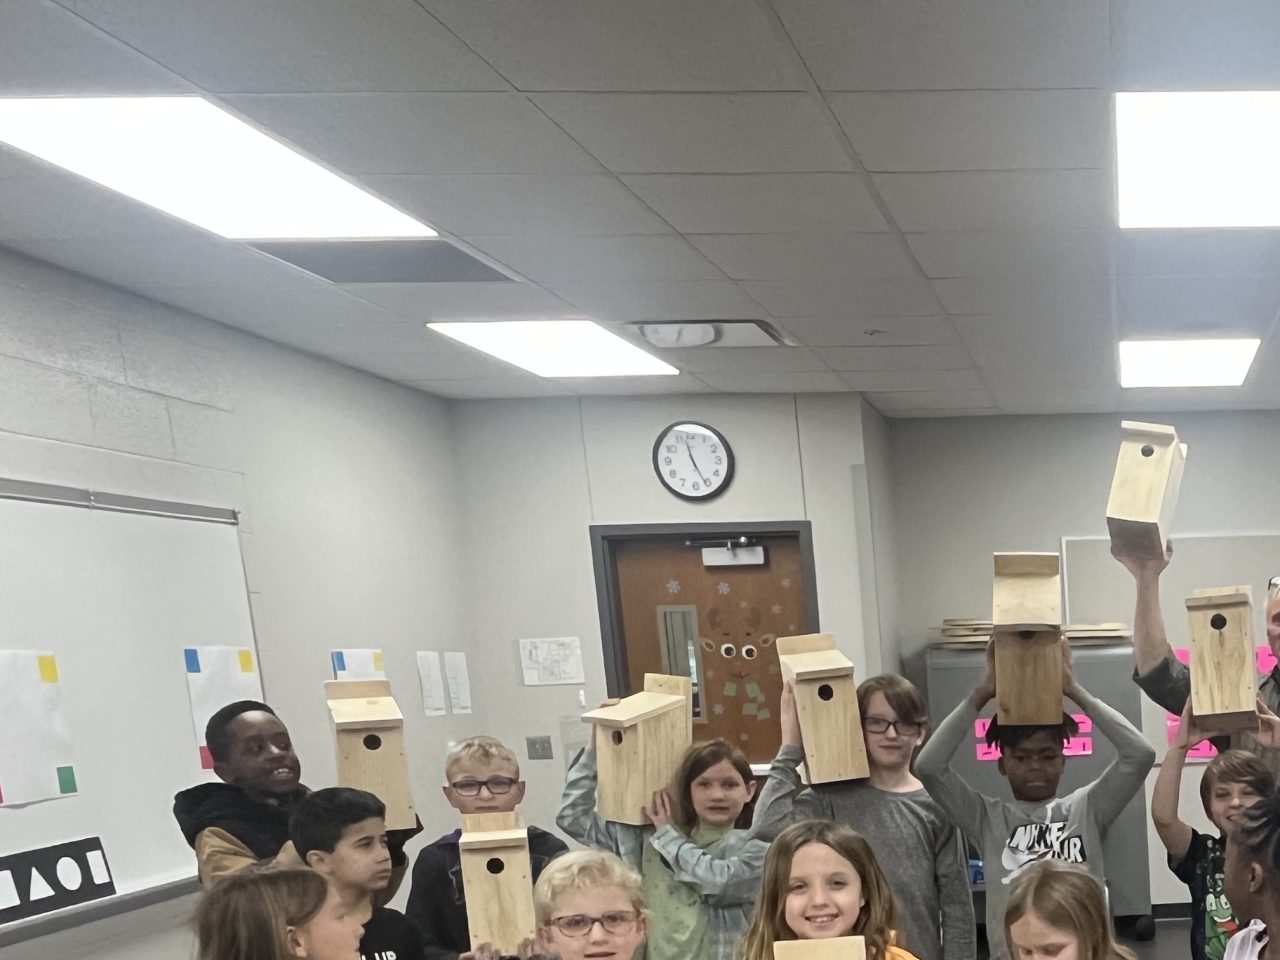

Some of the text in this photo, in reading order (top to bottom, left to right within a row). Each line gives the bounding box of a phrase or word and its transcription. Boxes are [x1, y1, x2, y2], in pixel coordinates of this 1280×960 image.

[675, 435, 683, 444] 11
[666, 444, 677, 454] 10
[710, 444, 718, 453] 2
[664, 456, 671, 465] 9
[714, 455, 721, 465] 3
[669, 469, 676, 478] 8
[713, 469, 720, 477] 4
[679, 478, 685, 487] 7
[692, 482, 699, 490] 6
[1009, 822, 1064, 852] NIKE
